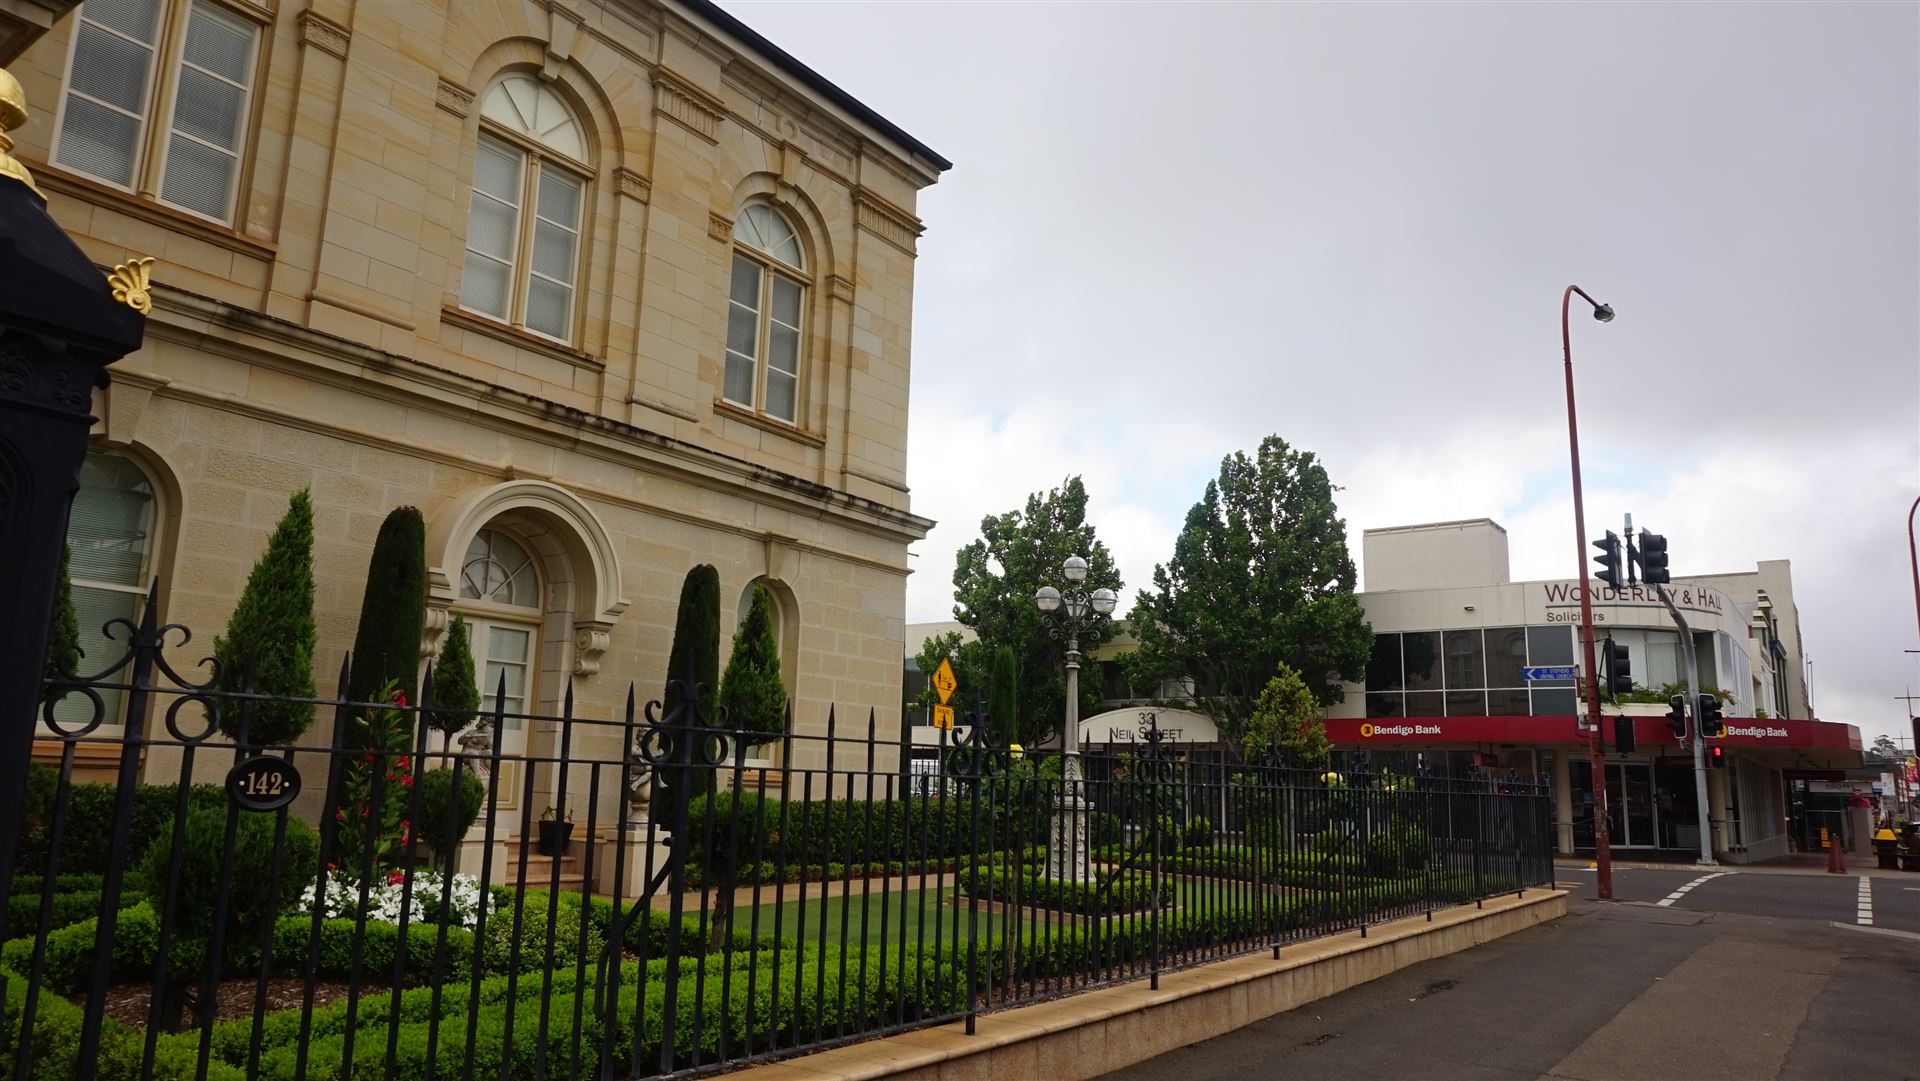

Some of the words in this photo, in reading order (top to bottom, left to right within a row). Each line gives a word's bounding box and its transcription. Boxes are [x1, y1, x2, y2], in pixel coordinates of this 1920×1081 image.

[1544, 583, 1677, 603] WONDERLY
[1682, 590, 1693, 604] &
[1546, 611, 1605, 622] Solicirs
[1138, 726, 1183, 740] SEET
[1374, 725, 1413, 736] Bendigo
[1415, 725, 1441, 734] Bank
[1728, 726, 1766, 738] Bendigo
[1767, 727, 1788, 737] Bank
[246, 771, 282, 795] 142
